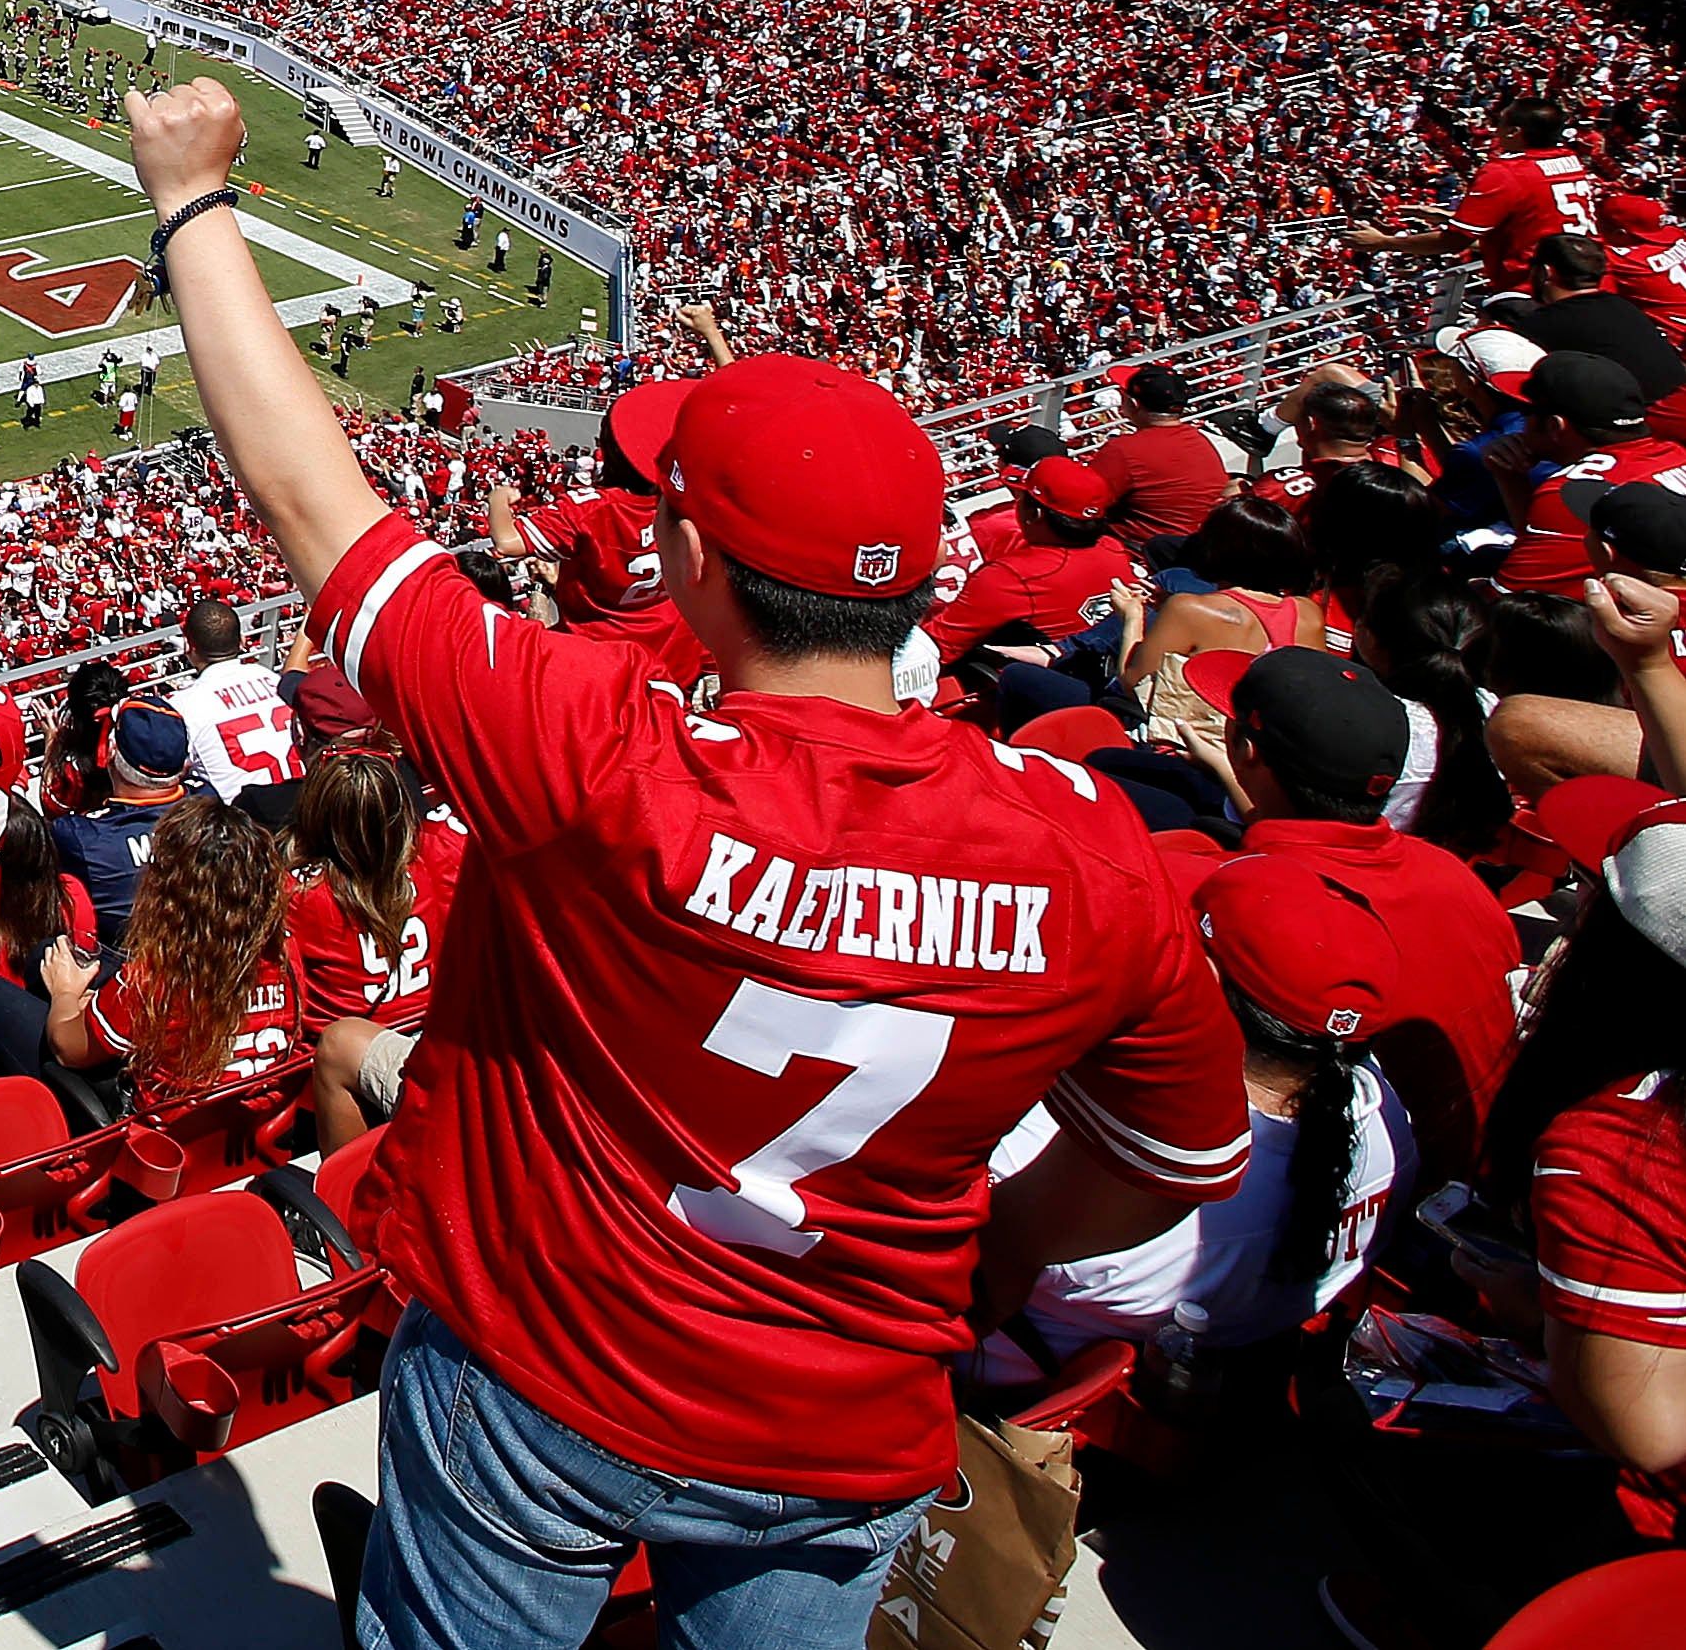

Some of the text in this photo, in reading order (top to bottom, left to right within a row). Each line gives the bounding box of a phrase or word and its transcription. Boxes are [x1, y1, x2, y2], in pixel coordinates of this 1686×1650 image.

[399, 130, 446, 170] BOWL
[454, 159, 570, 239] CHAMPIONS
[894, 664, 937, 691] ERNICK
[686, 831, 1049, 974] KAEPERNICK
[666, 976, 956, 1259] 7
